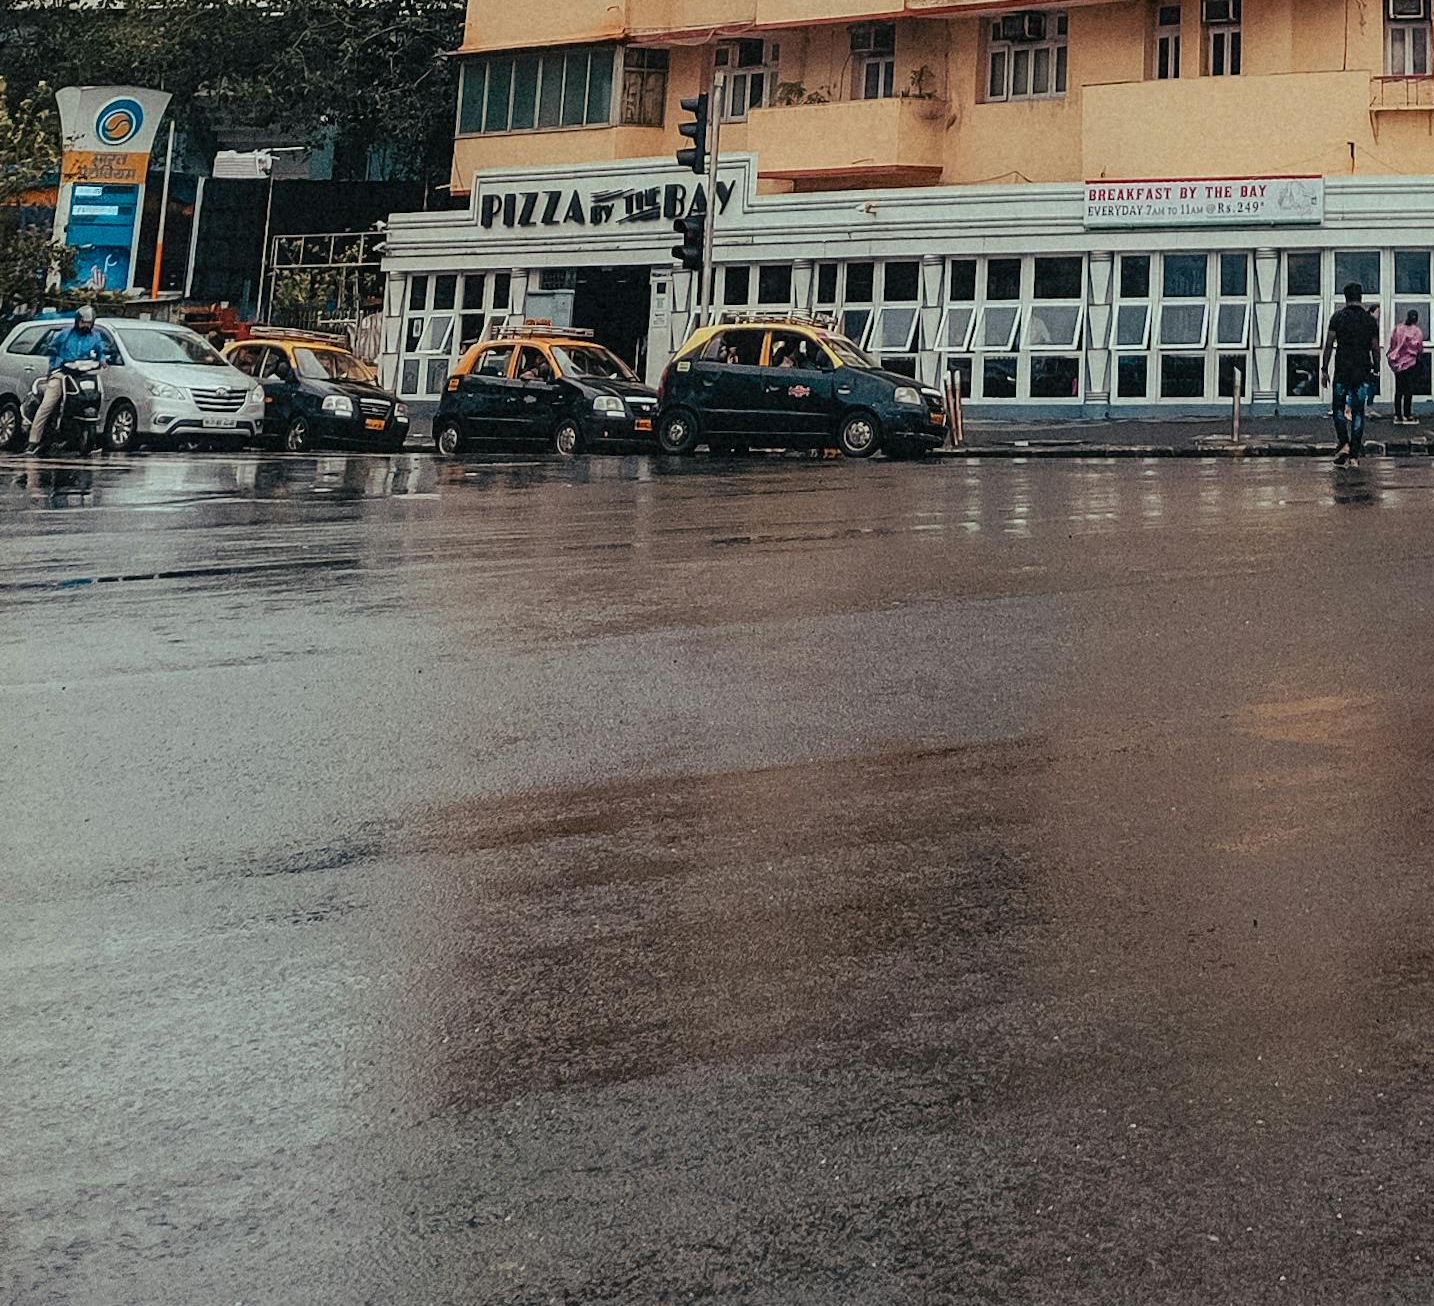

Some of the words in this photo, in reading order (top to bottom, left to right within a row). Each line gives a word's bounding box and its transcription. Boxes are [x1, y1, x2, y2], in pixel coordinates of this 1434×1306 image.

[1088, 187, 1172, 202] BREAKFAST
[1180, 186, 1197, 199] BY
[1205, 185, 1232, 199] THE
[1240, 184, 1267, 198] BAY
[481, 189, 586, 229] PIZZA
[589, 202, 615, 226] BY
[622, 187, 661, 215] THE
[663, 179, 737, 220] BAY
[1088, 204, 1143, 217] EVERYDAY
[1146, 204, 1165, 216] 7AM
[1168, 205, 1178, 215] TO
